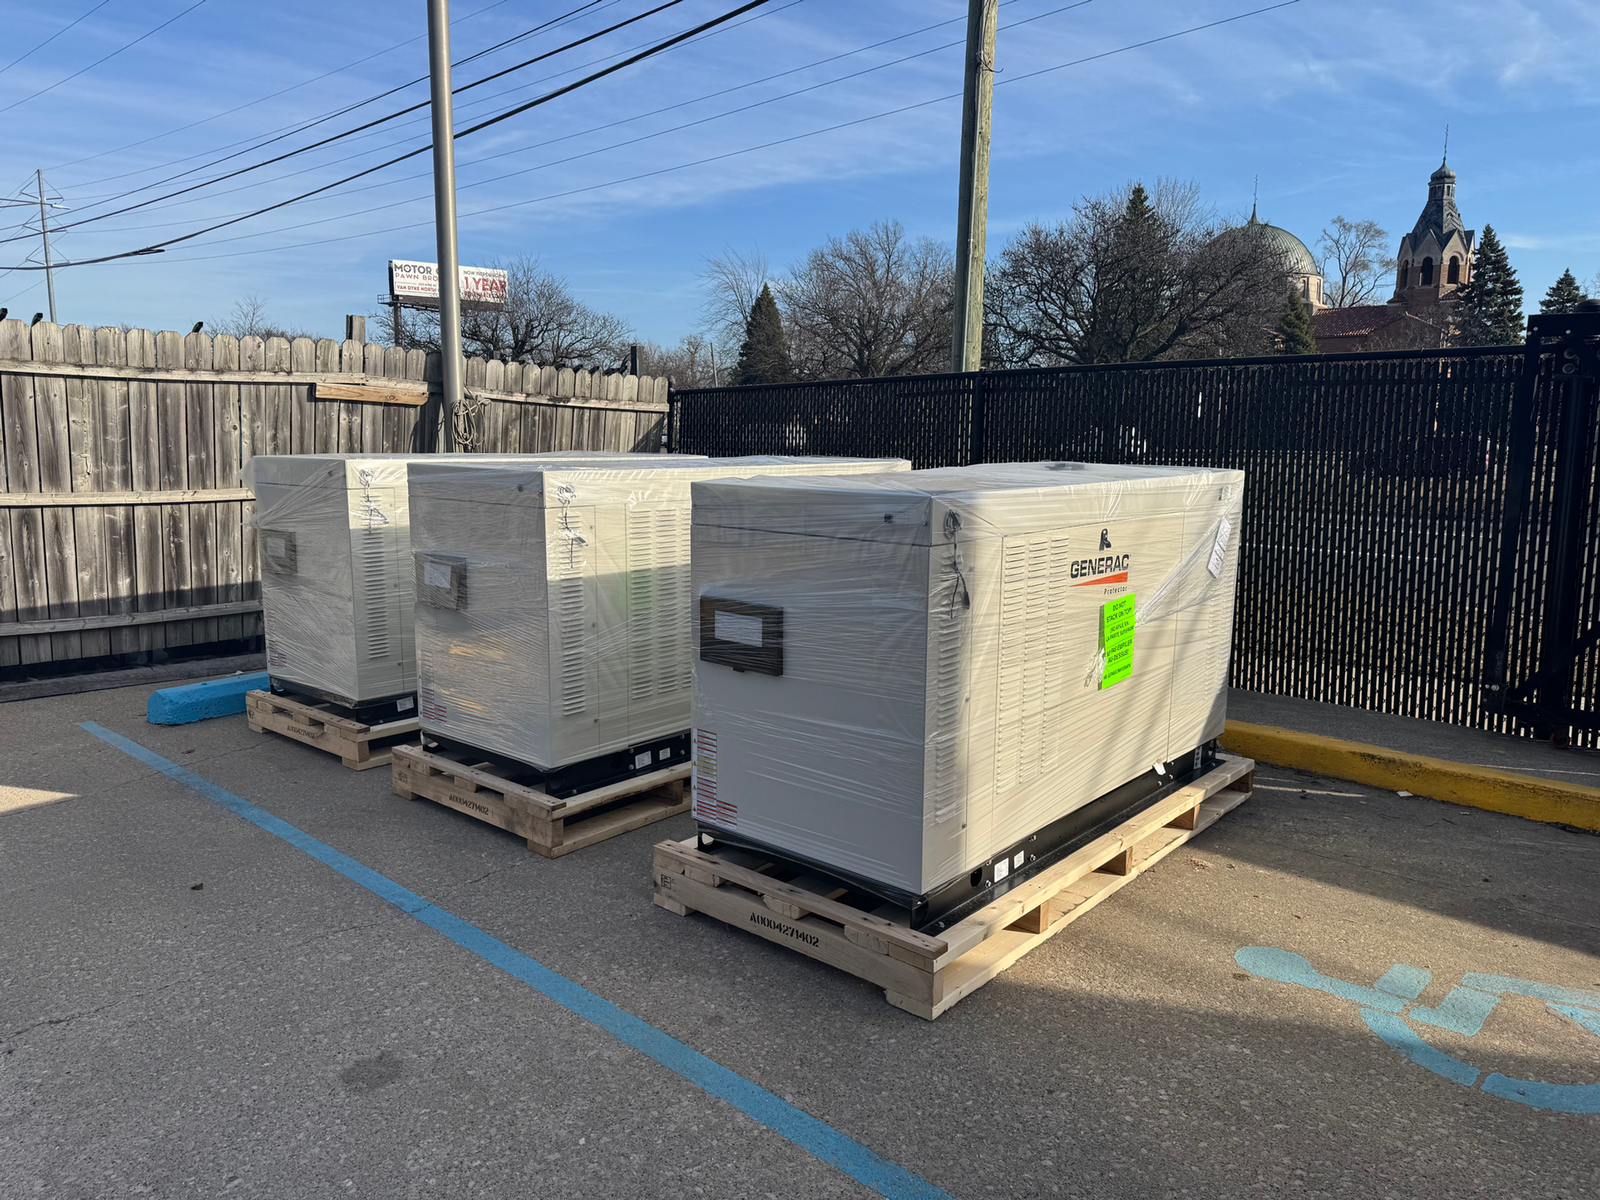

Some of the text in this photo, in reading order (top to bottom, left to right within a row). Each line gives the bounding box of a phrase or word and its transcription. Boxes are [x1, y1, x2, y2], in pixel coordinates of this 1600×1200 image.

[394, 263, 432, 275] MOTOR
[395, 272, 439, 282] PAWN BRO
[464, 276, 507, 293] 1 YEAR
[1070, 553, 1130, 579] GENERAC
[1103, 585, 1128, 595] Protector
[1112, 600, 1127, 612] DO NOT
[1106, 612, 1119, 623] STACK
[448, 793, 489, 816] A0004271402
[750, 911, 820, 948] A0004271402
